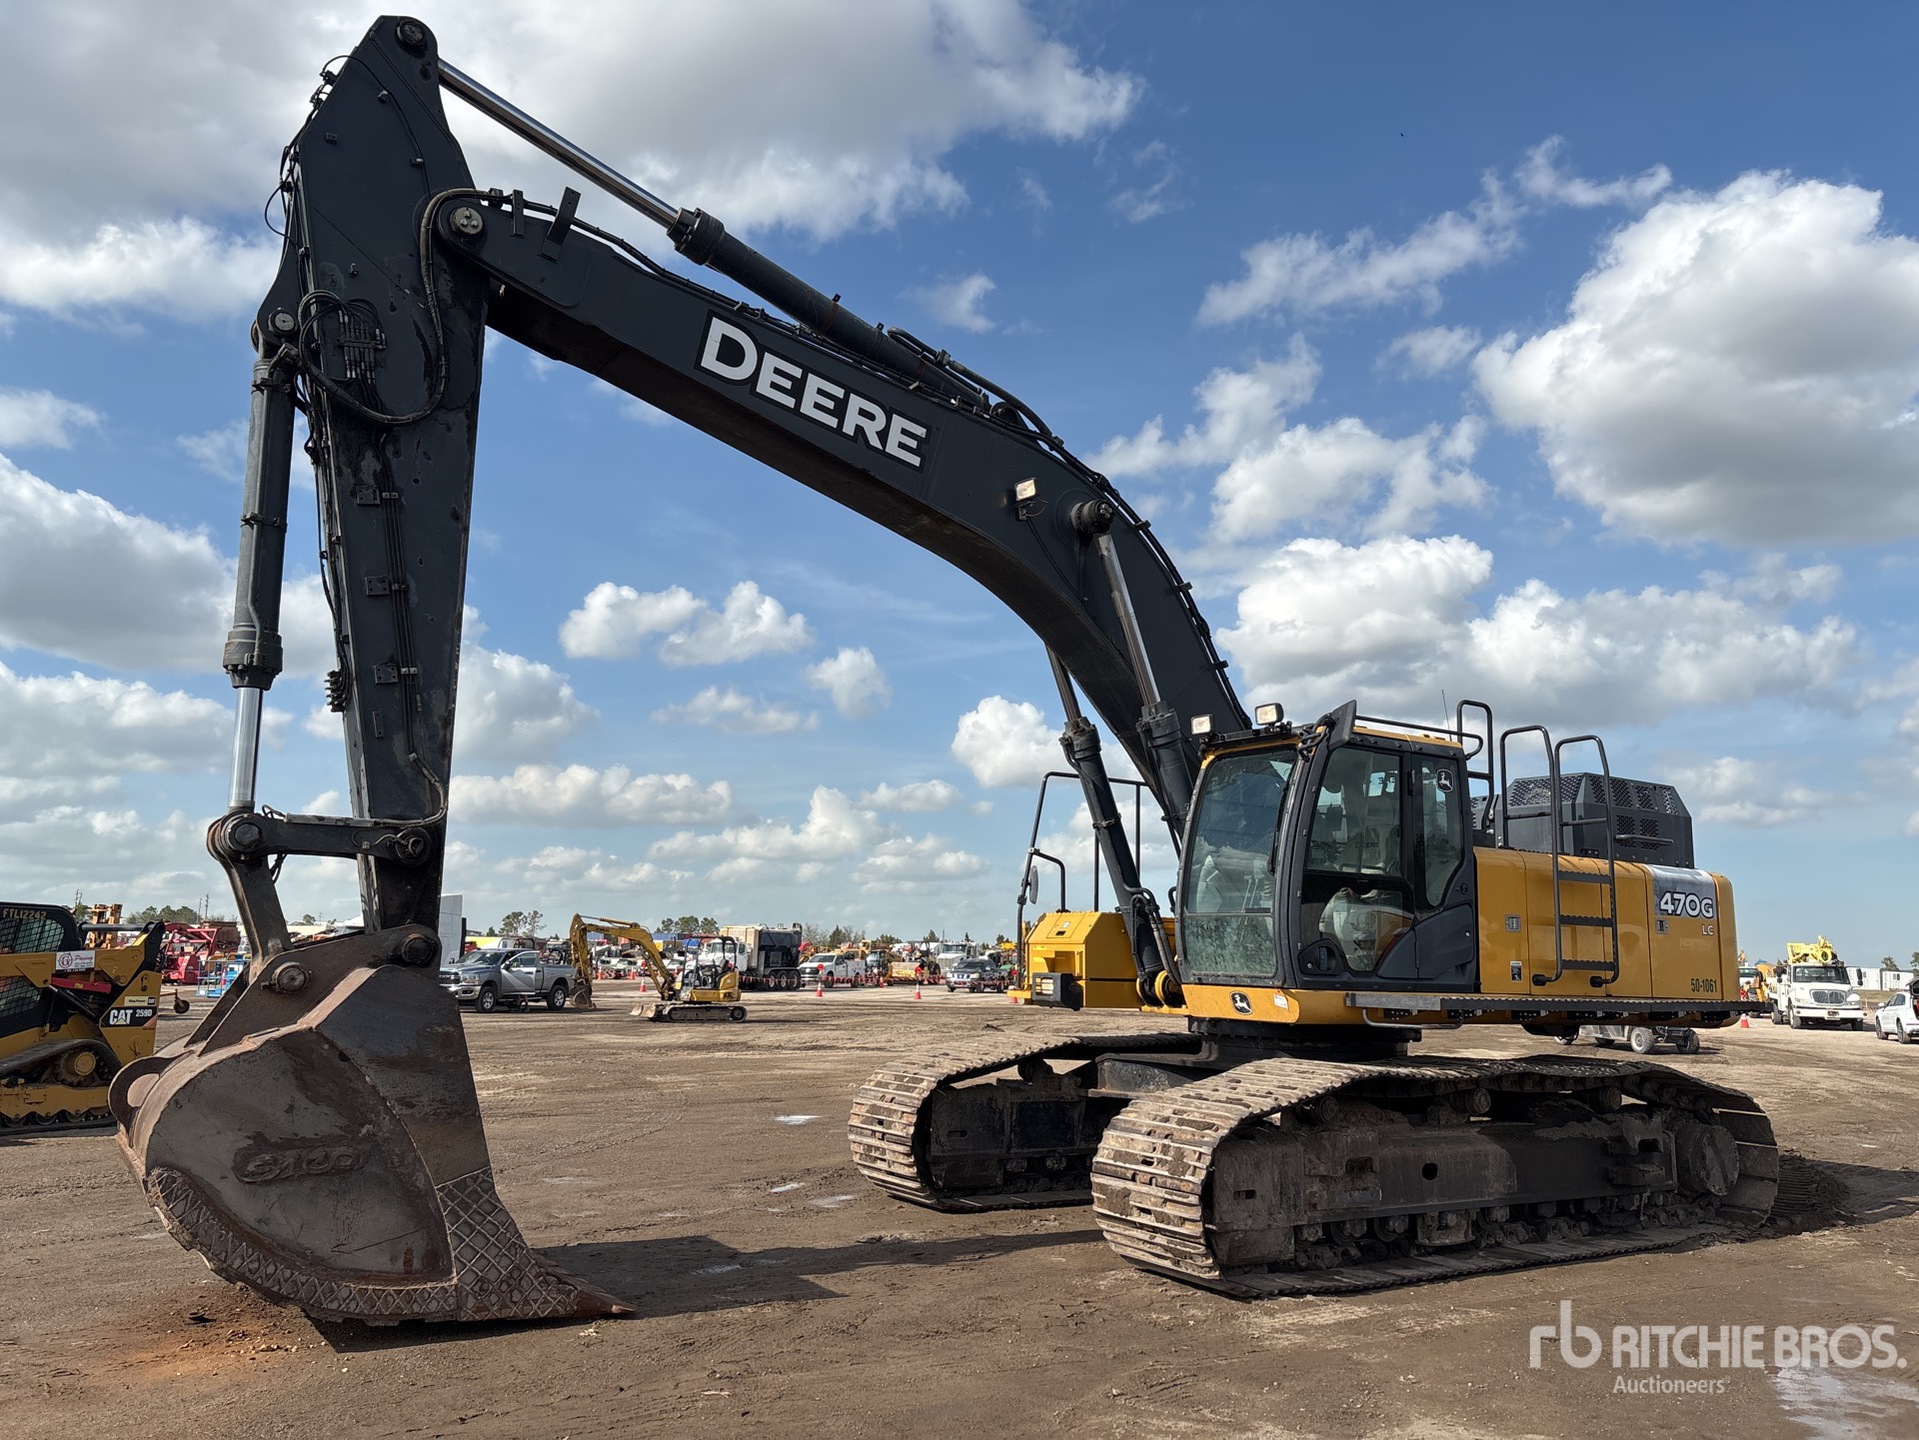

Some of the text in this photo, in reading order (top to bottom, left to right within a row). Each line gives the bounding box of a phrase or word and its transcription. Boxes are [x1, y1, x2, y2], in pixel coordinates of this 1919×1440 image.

[701, 317, 927, 467] DEERE
[1659, 891, 1714, 919] 470G
[1702, 924, 1714, 935] LC
[1690, 978, 1717, 993] 50-1061
[109, 1009, 153, 1025] CAT 259D
